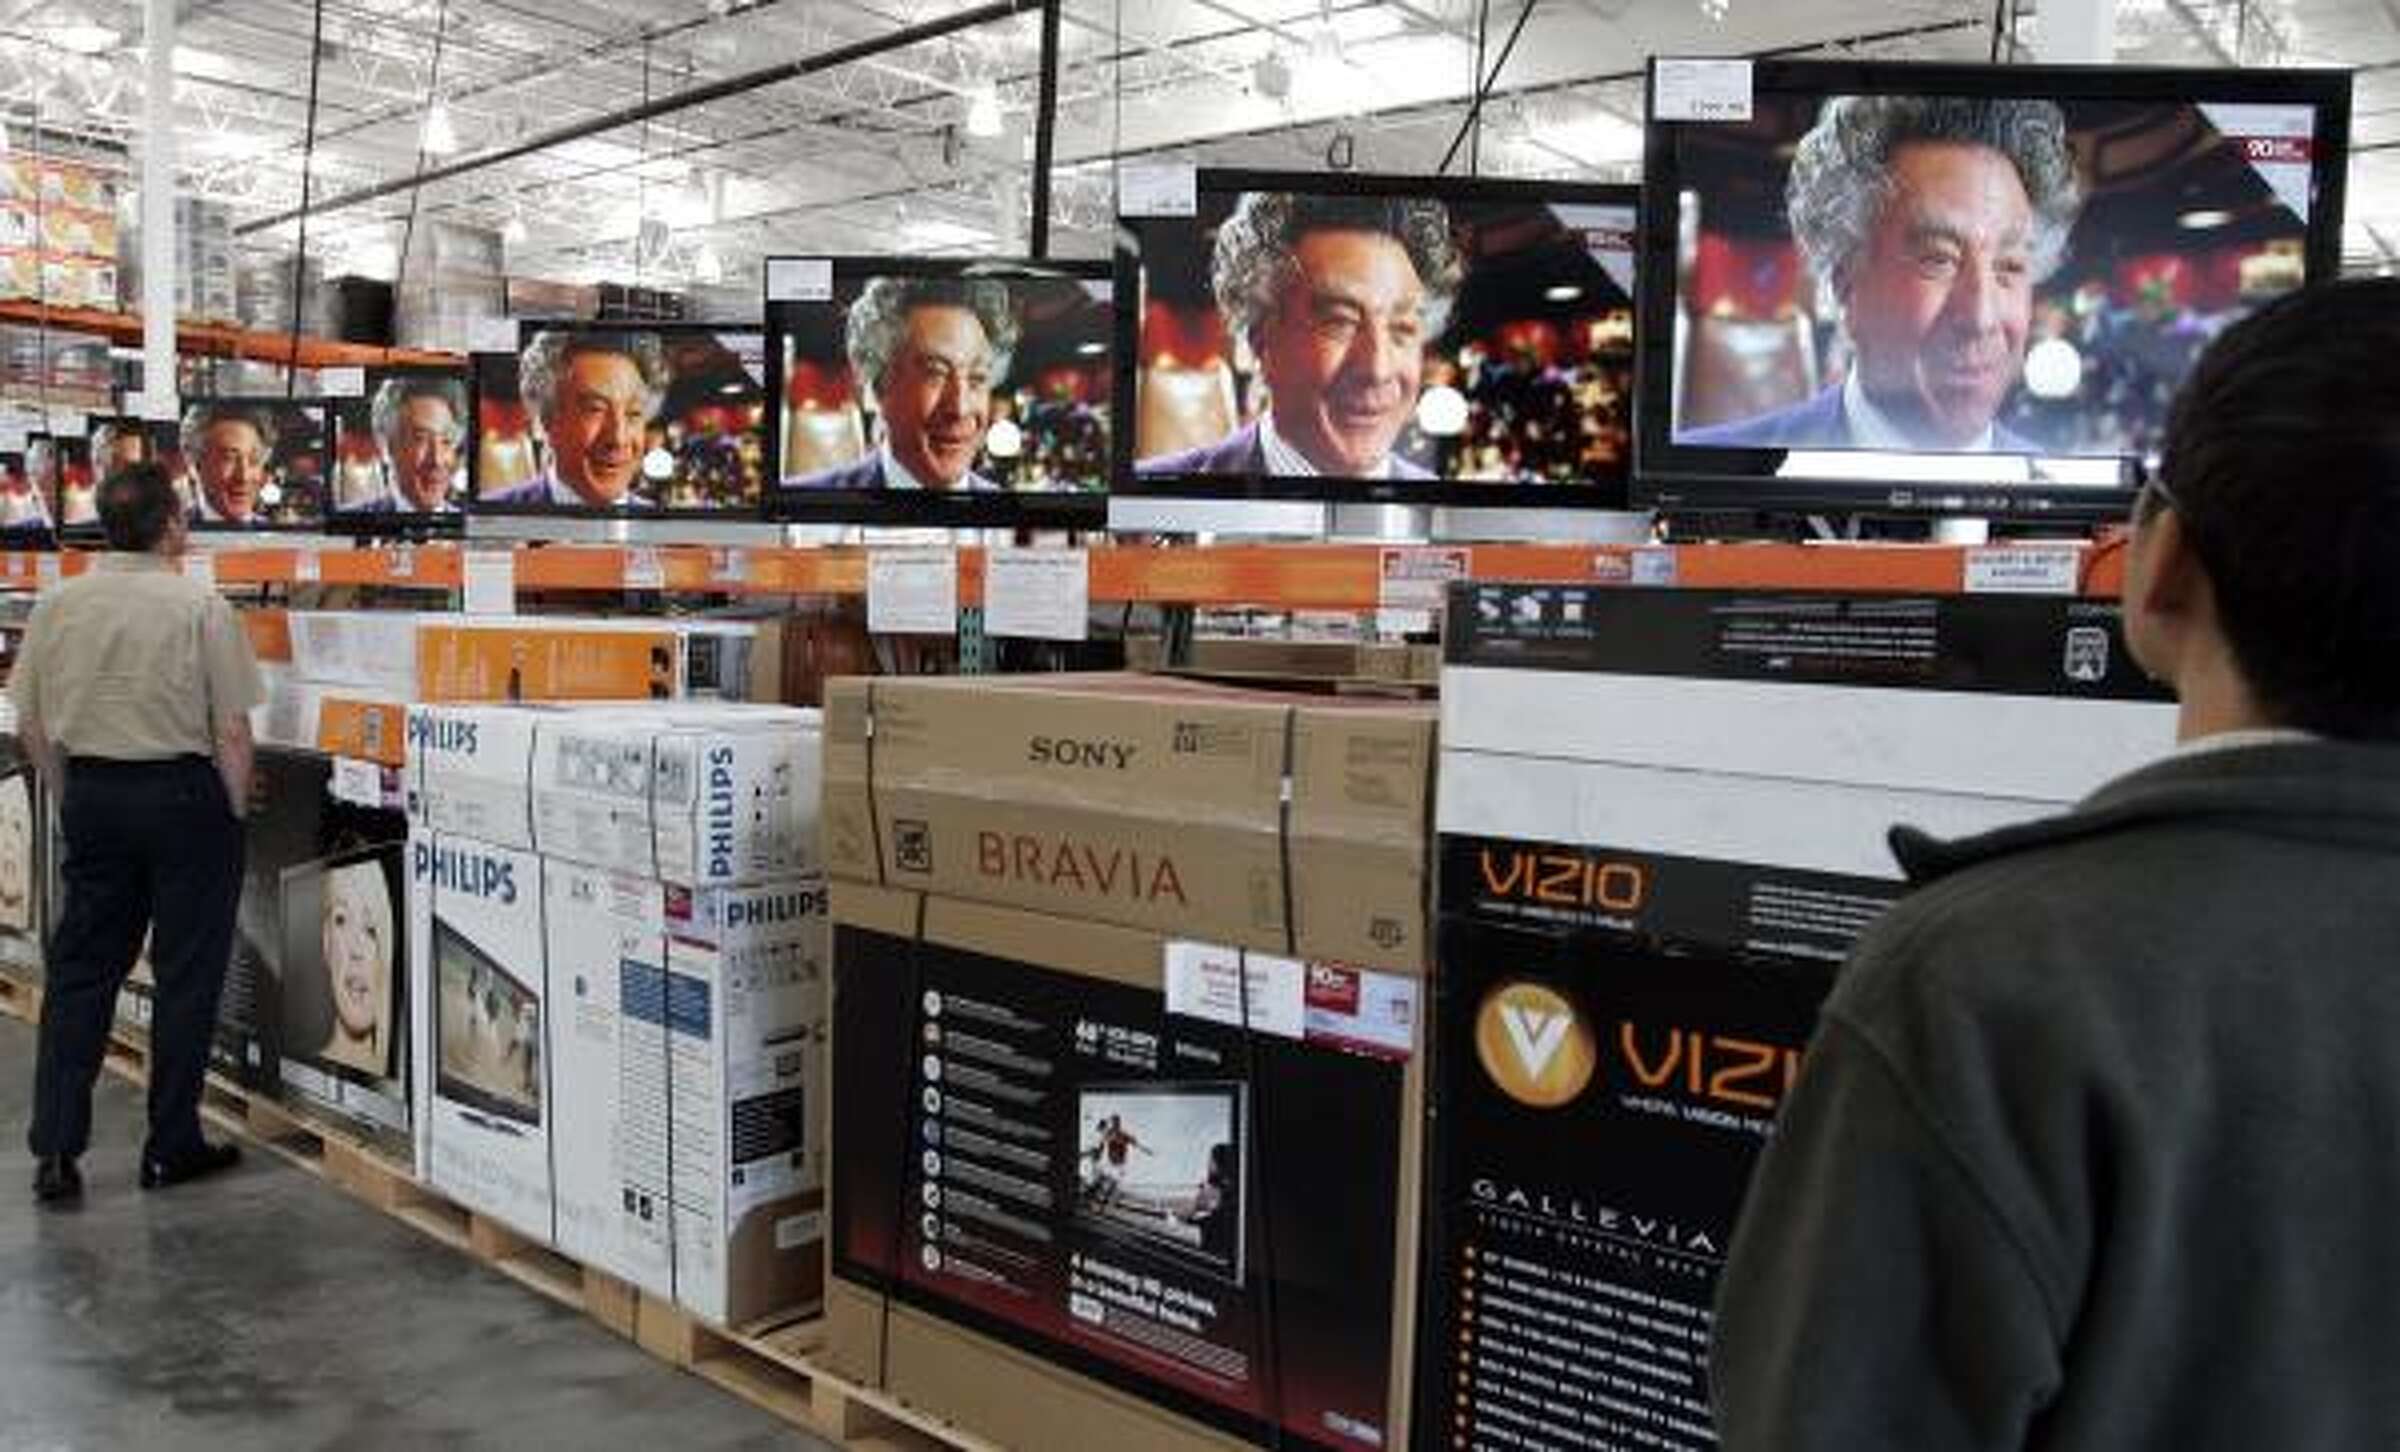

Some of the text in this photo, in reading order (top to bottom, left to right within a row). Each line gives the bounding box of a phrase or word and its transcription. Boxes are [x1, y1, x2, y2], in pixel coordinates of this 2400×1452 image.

[408, 713, 478, 755] PHILIPS
[1028, 735, 1137, 769] SONY
[709, 747, 733, 877] PHILIPS
[414, 842, 516, 904] PHILIPS
[979, 831, 1188, 902] BRAVIA
[1482, 846, 1642, 909] VIZIO
[727, 888, 829, 929] PHILIPS
[1621, 1020, 1798, 1109] VIZI
[1472, 1178, 1717, 1254] GALLEVIA
